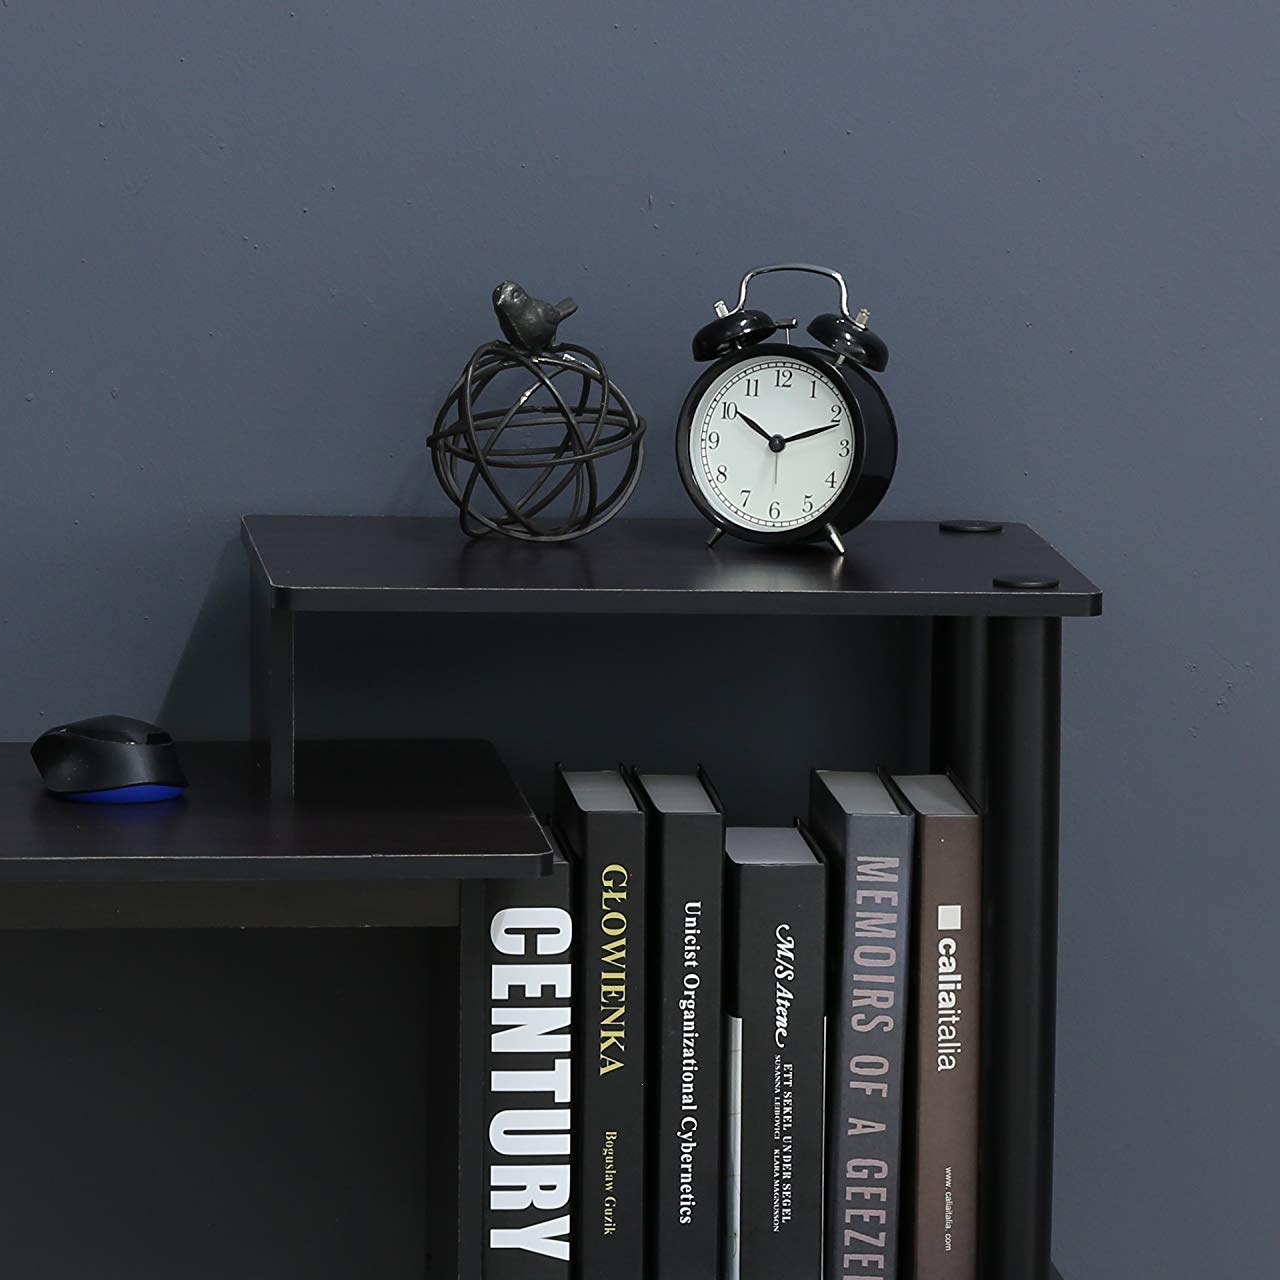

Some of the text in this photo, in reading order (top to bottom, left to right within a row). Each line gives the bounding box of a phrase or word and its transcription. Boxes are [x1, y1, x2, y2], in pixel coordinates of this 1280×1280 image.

[744, 379, 760, 397] 11
[774, 370, 793, 388] 12
[809, 380, 817, 399] 1
[721, 401, 738, 420] 10
[831, 404, 842, 423] 2
[708, 431, 719, 450] 9
[839, 440, 850, 457] 3
[716, 465, 728, 483] 8
[825, 471, 837, 489] 4
[740, 490, 751, 508] 7
[802, 495, 813, 513] 5
[769, 501, 780, 519] 6
[849, 855, 899, 1033] MEMOIRS
[599, 863, 628, 1076] GŁOWIENKA
[774, 924, 795, 1048] M/S Atene
[937, 937, 962, 1071] caliaitalia
[677, 901, 701, 1224] Unicist Organizational Cybernetics
[489, 907, 573, 1261] CENTURY
[848, 1055, 889, 1098] OF
[847, 1117, 886, 1136] A
[781, 1063, 793, 1223] ETT SEKEL UNDER SEGEL
[603, 1196, 617, 1235] Guzik
